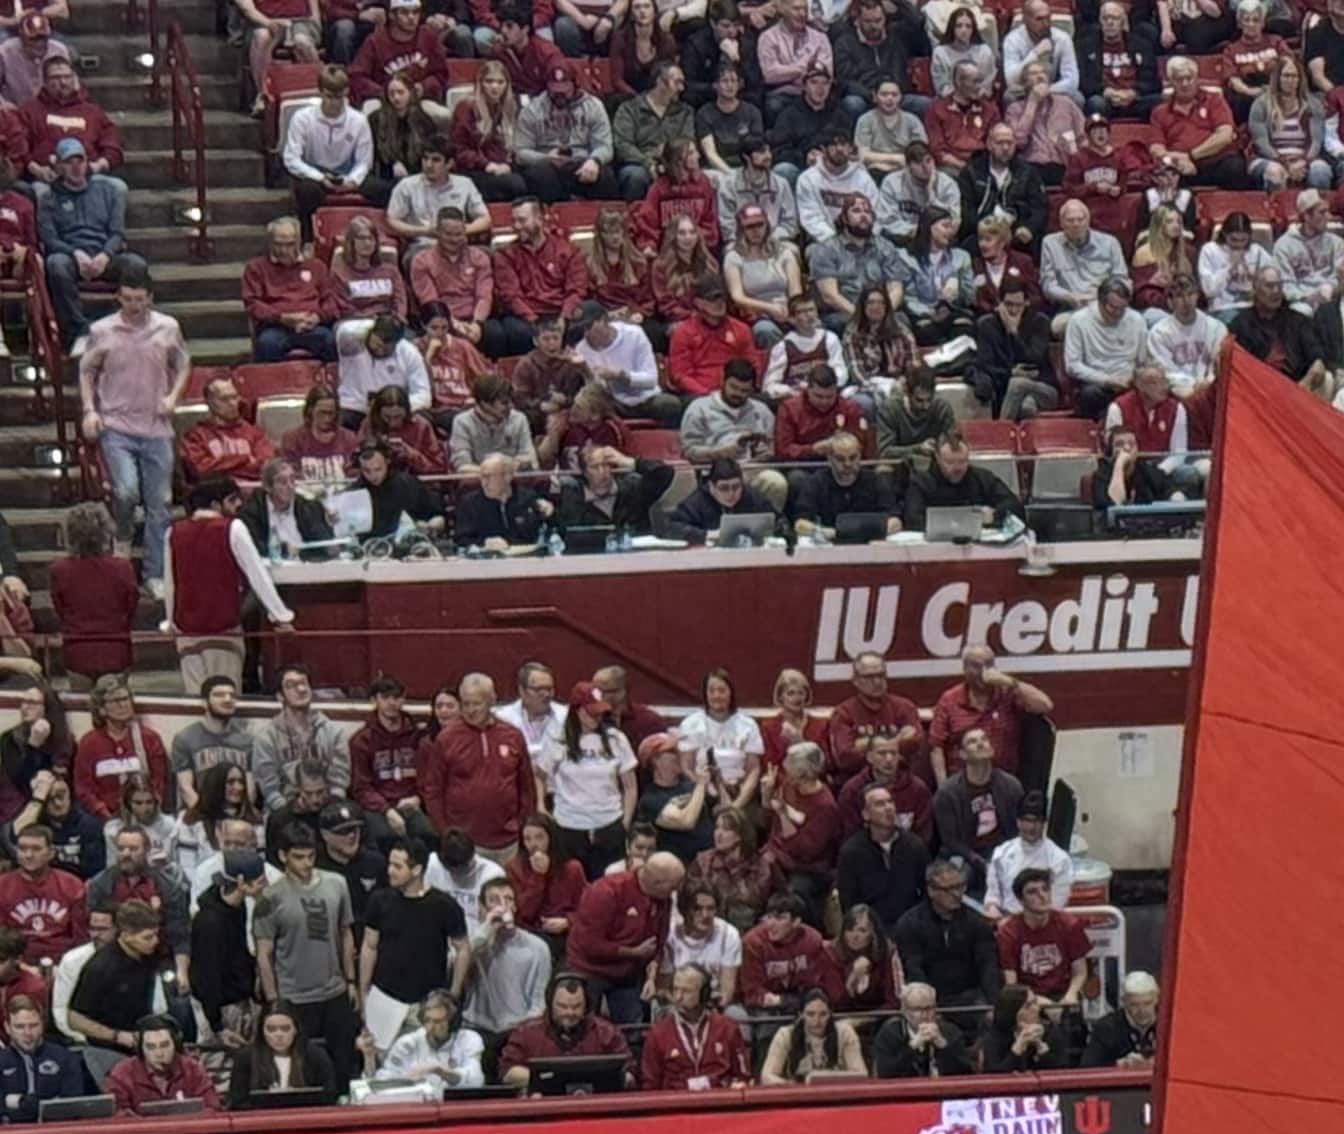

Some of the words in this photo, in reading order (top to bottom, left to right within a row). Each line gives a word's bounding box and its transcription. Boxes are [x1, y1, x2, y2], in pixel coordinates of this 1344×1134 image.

[815, 585, 900, 662] IU
[920, 574, 1159, 657] Credit
[9, 897, 67, 925] INDIANA
